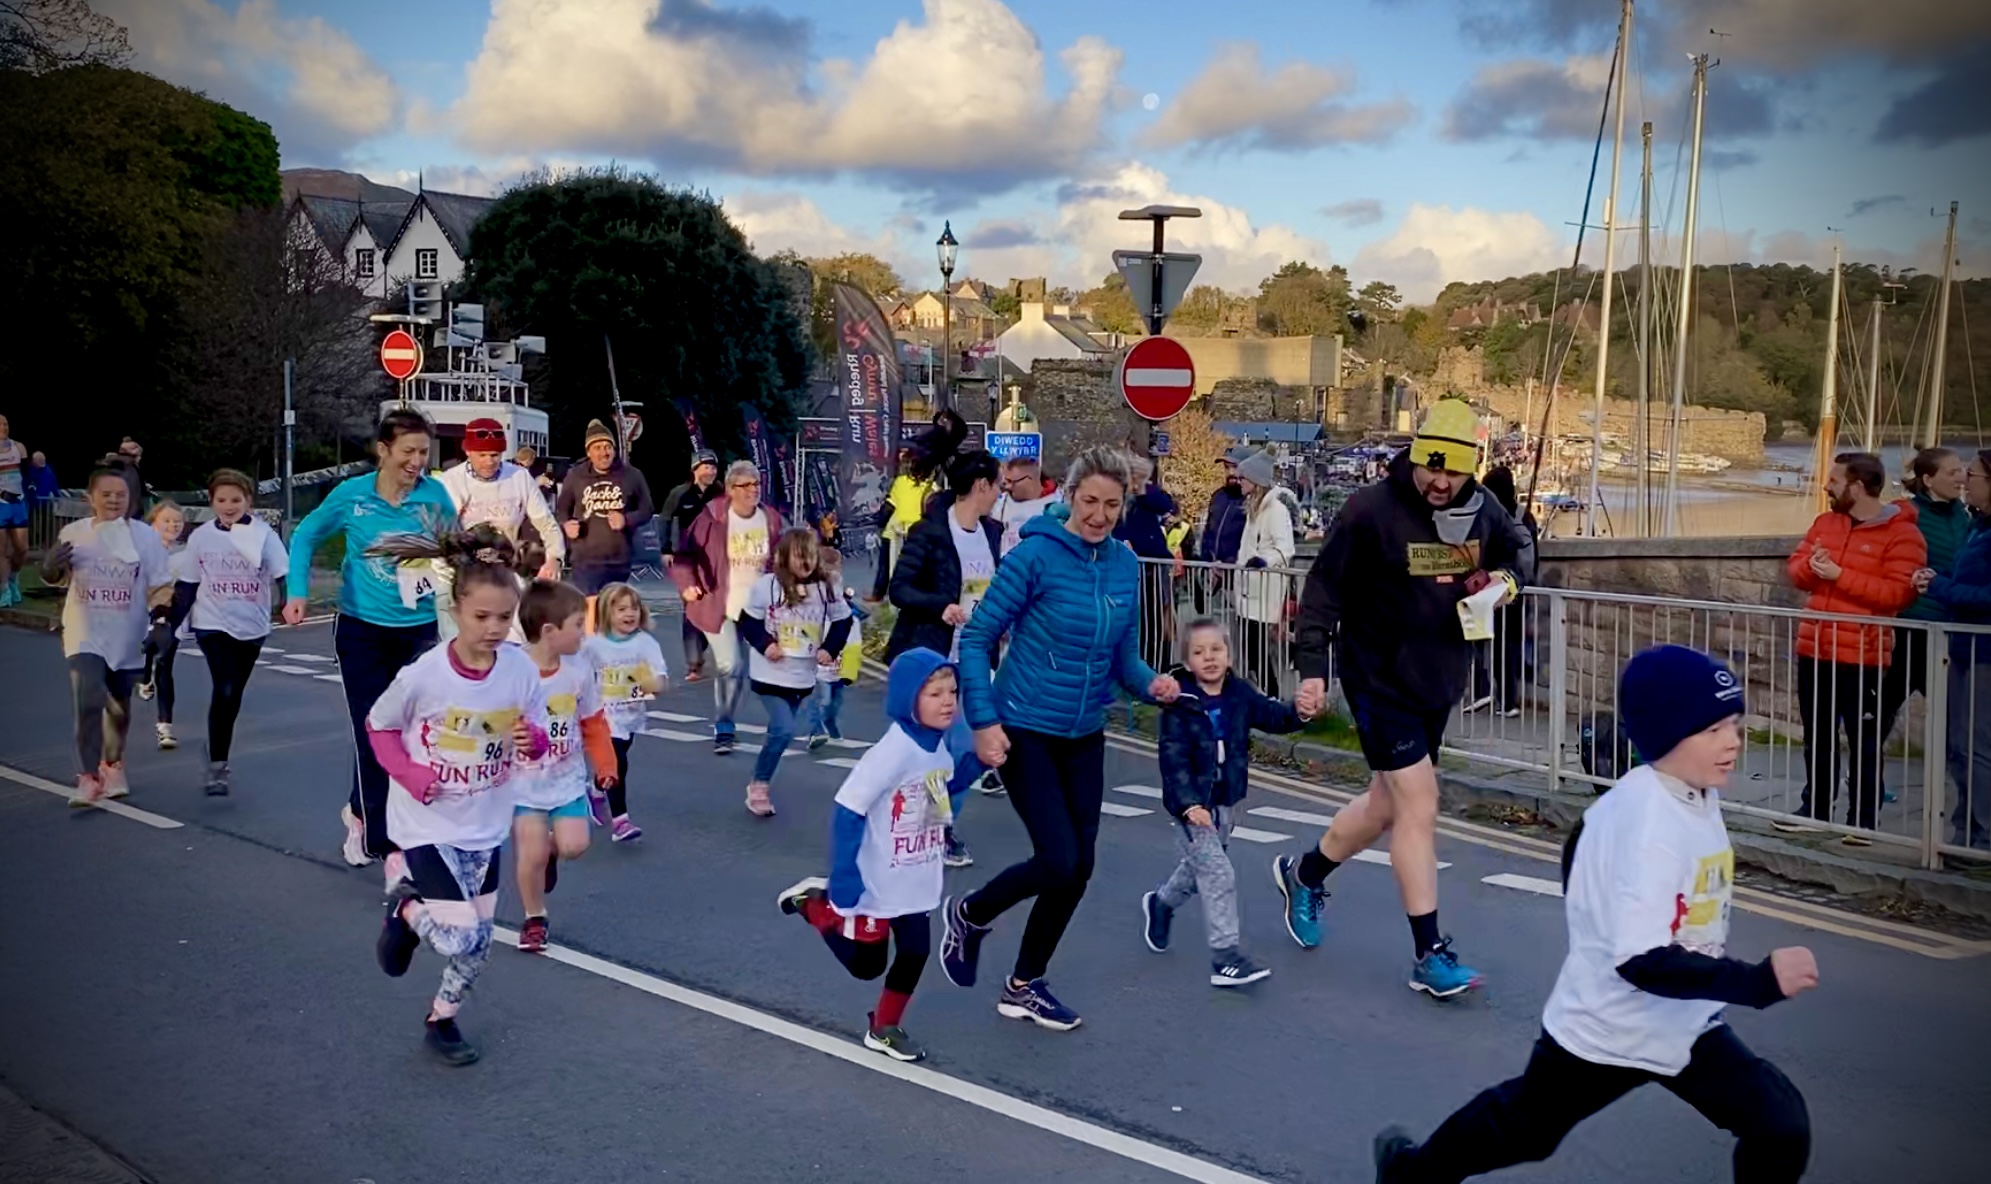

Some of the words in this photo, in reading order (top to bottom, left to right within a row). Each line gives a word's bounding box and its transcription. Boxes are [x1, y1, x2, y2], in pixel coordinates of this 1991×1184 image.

[994, 436, 1033, 446] DIWEDD
[991, 446, 998, 455] Y
[583, 499, 625, 519] Jones
[101, 589, 131, 602] RUN
[231, 582, 259, 595] RUN
[550, 721, 567, 738] 86
[485, 740, 503, 761] 96
[894, 831, 926, 855] FUN
